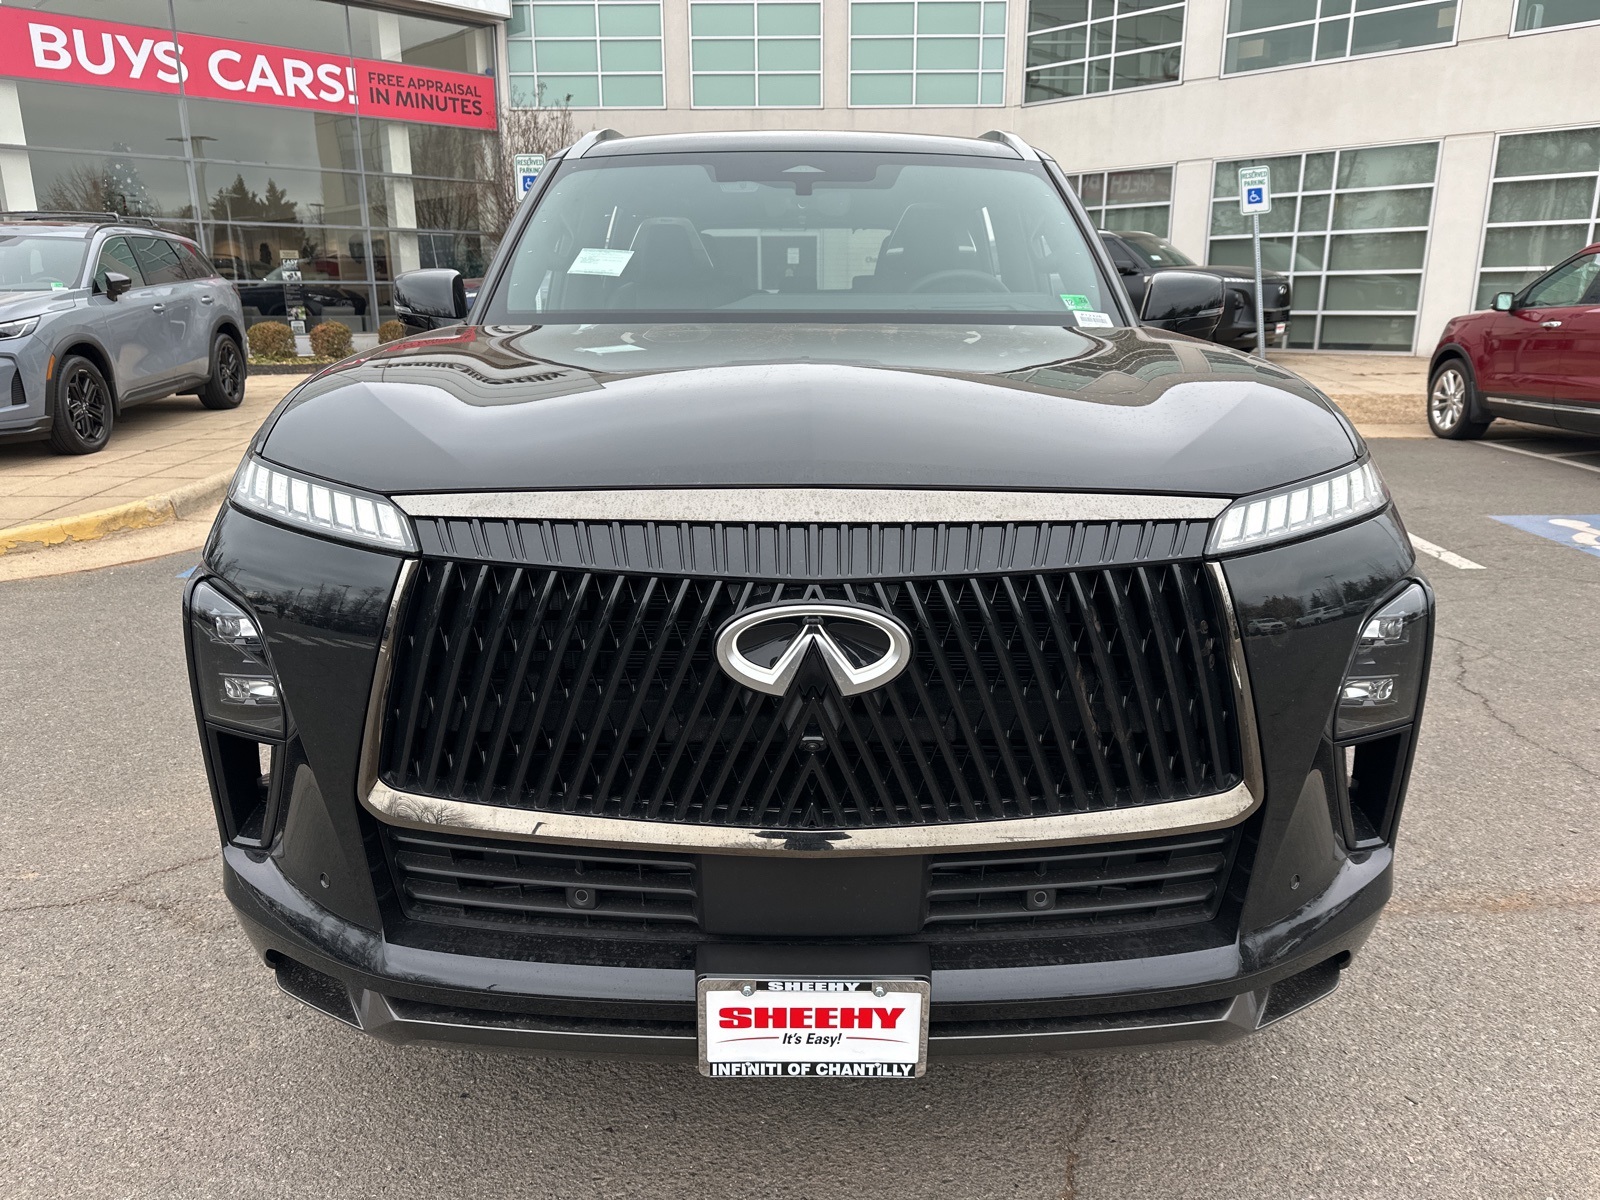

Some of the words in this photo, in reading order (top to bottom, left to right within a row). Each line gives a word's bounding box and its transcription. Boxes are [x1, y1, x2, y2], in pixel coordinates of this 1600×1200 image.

[28, 22, 189, 84] BUYS
[207, 49, 359, 105] CARS!
[368, 72, 405, 88] FREE
[407, 77, 482, 98] APPRAISAL
[369, 87, 390, 105] IN
[395, 90, 483, 116] MINUTES
[1240, 170, 1268, 179] RESERVED
[1243, 178, 1266, 187] PARKING
[767, 981, 860, 992] SHEEHY
[718, 1007, 906, 1029] SHEEHY
[782, 1033, 802, 1045] It's
[806, 1033, 843, 1048] Easy!
[712, 1063, 782, 1076] INFINITI
[787, 1062, 811, 1076] OF
[816, 1063, 913, 1077] CHANTILLY
